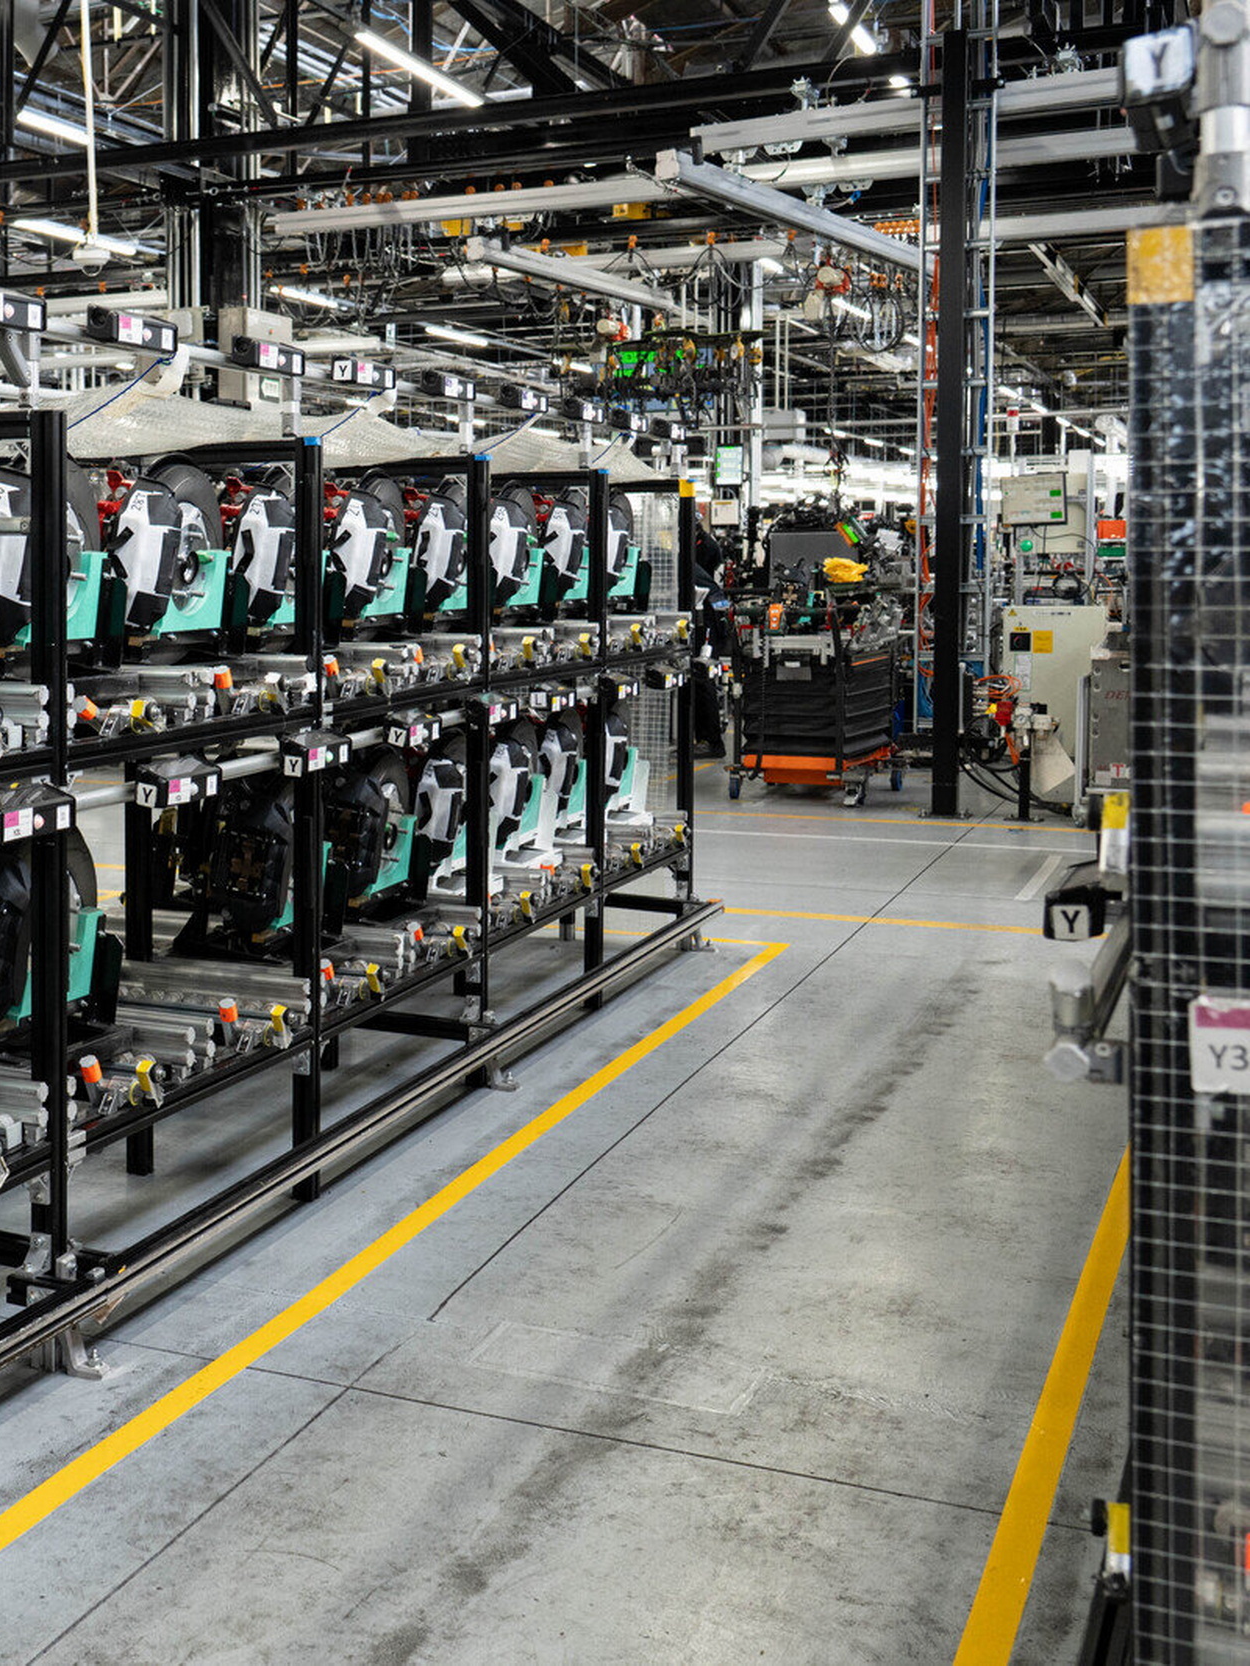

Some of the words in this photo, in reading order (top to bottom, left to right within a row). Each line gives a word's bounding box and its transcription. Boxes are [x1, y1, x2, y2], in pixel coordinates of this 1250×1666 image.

[1149, 42, 1169, 79] Y
[338, 365, 348, 378] Y
[394, 729, 404, 743] Y
[288, 758, 300, 773] Y
[142, 786, 154, 803] Y
[1060, 909, 1081, 934] Y
[1207, 1043, 1250, 1072] Y3
